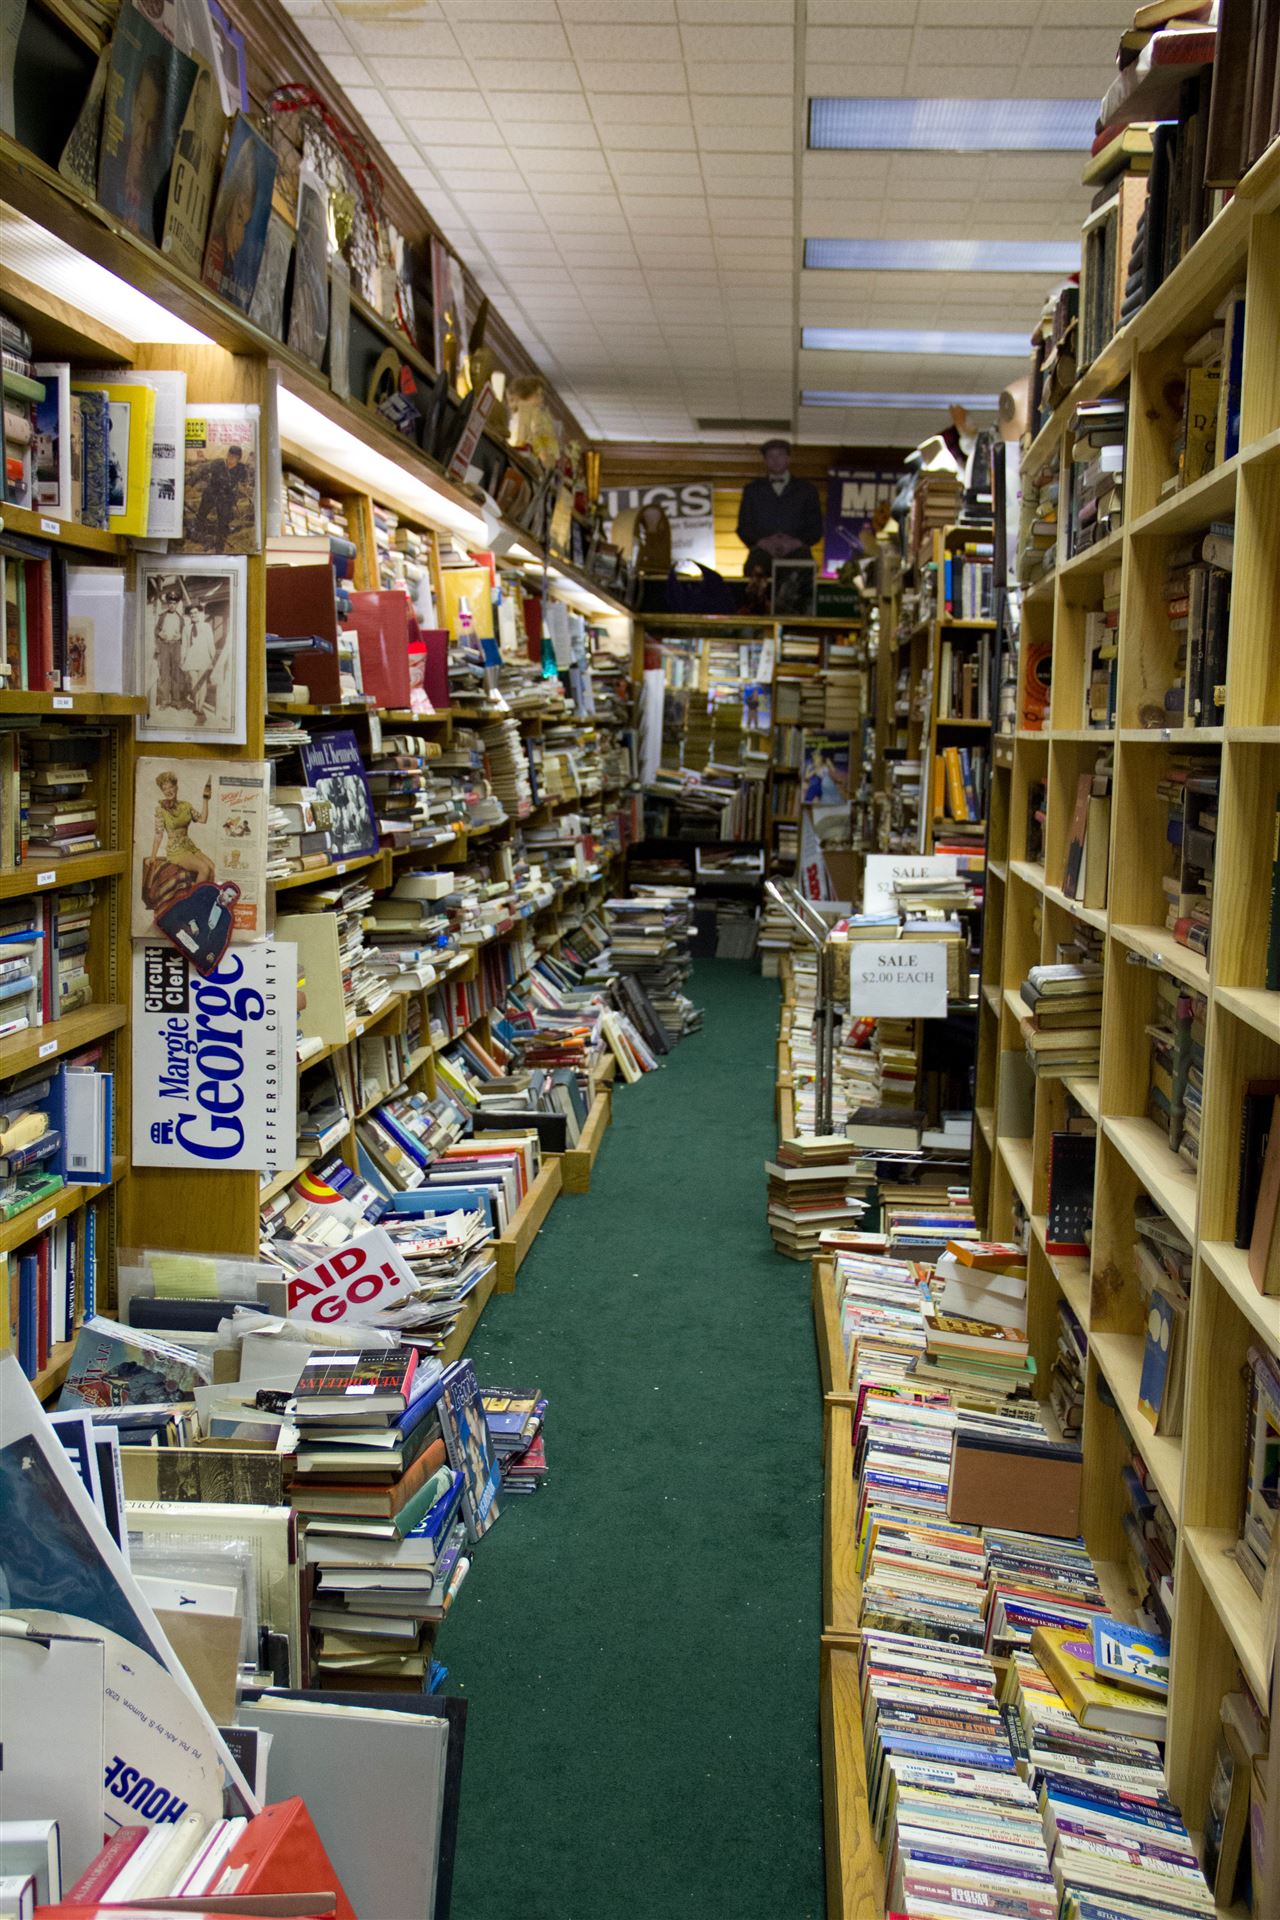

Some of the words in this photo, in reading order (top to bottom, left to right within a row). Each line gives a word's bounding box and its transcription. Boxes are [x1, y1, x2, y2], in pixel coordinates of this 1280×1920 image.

[892, 867, 930, 879] SALE
[145, 947, 164, 1012] Circuit
[166, 956, 185, 1013] Clerk
[266, 947, 277, 1031] COUNTY
[862, 971, 893, 984] $2.00
[897, 972, 934, 983] EACH
[878, 955, 918, 967] SALE
[159, 1017, 199, 1101] Margie
[176, 953, 264, 1160] George
[266, 1047, 277, 1168] JEFFERSON
[311, 1262, 401, 1324] GO!
[155, 1723, 165, 1735] by
